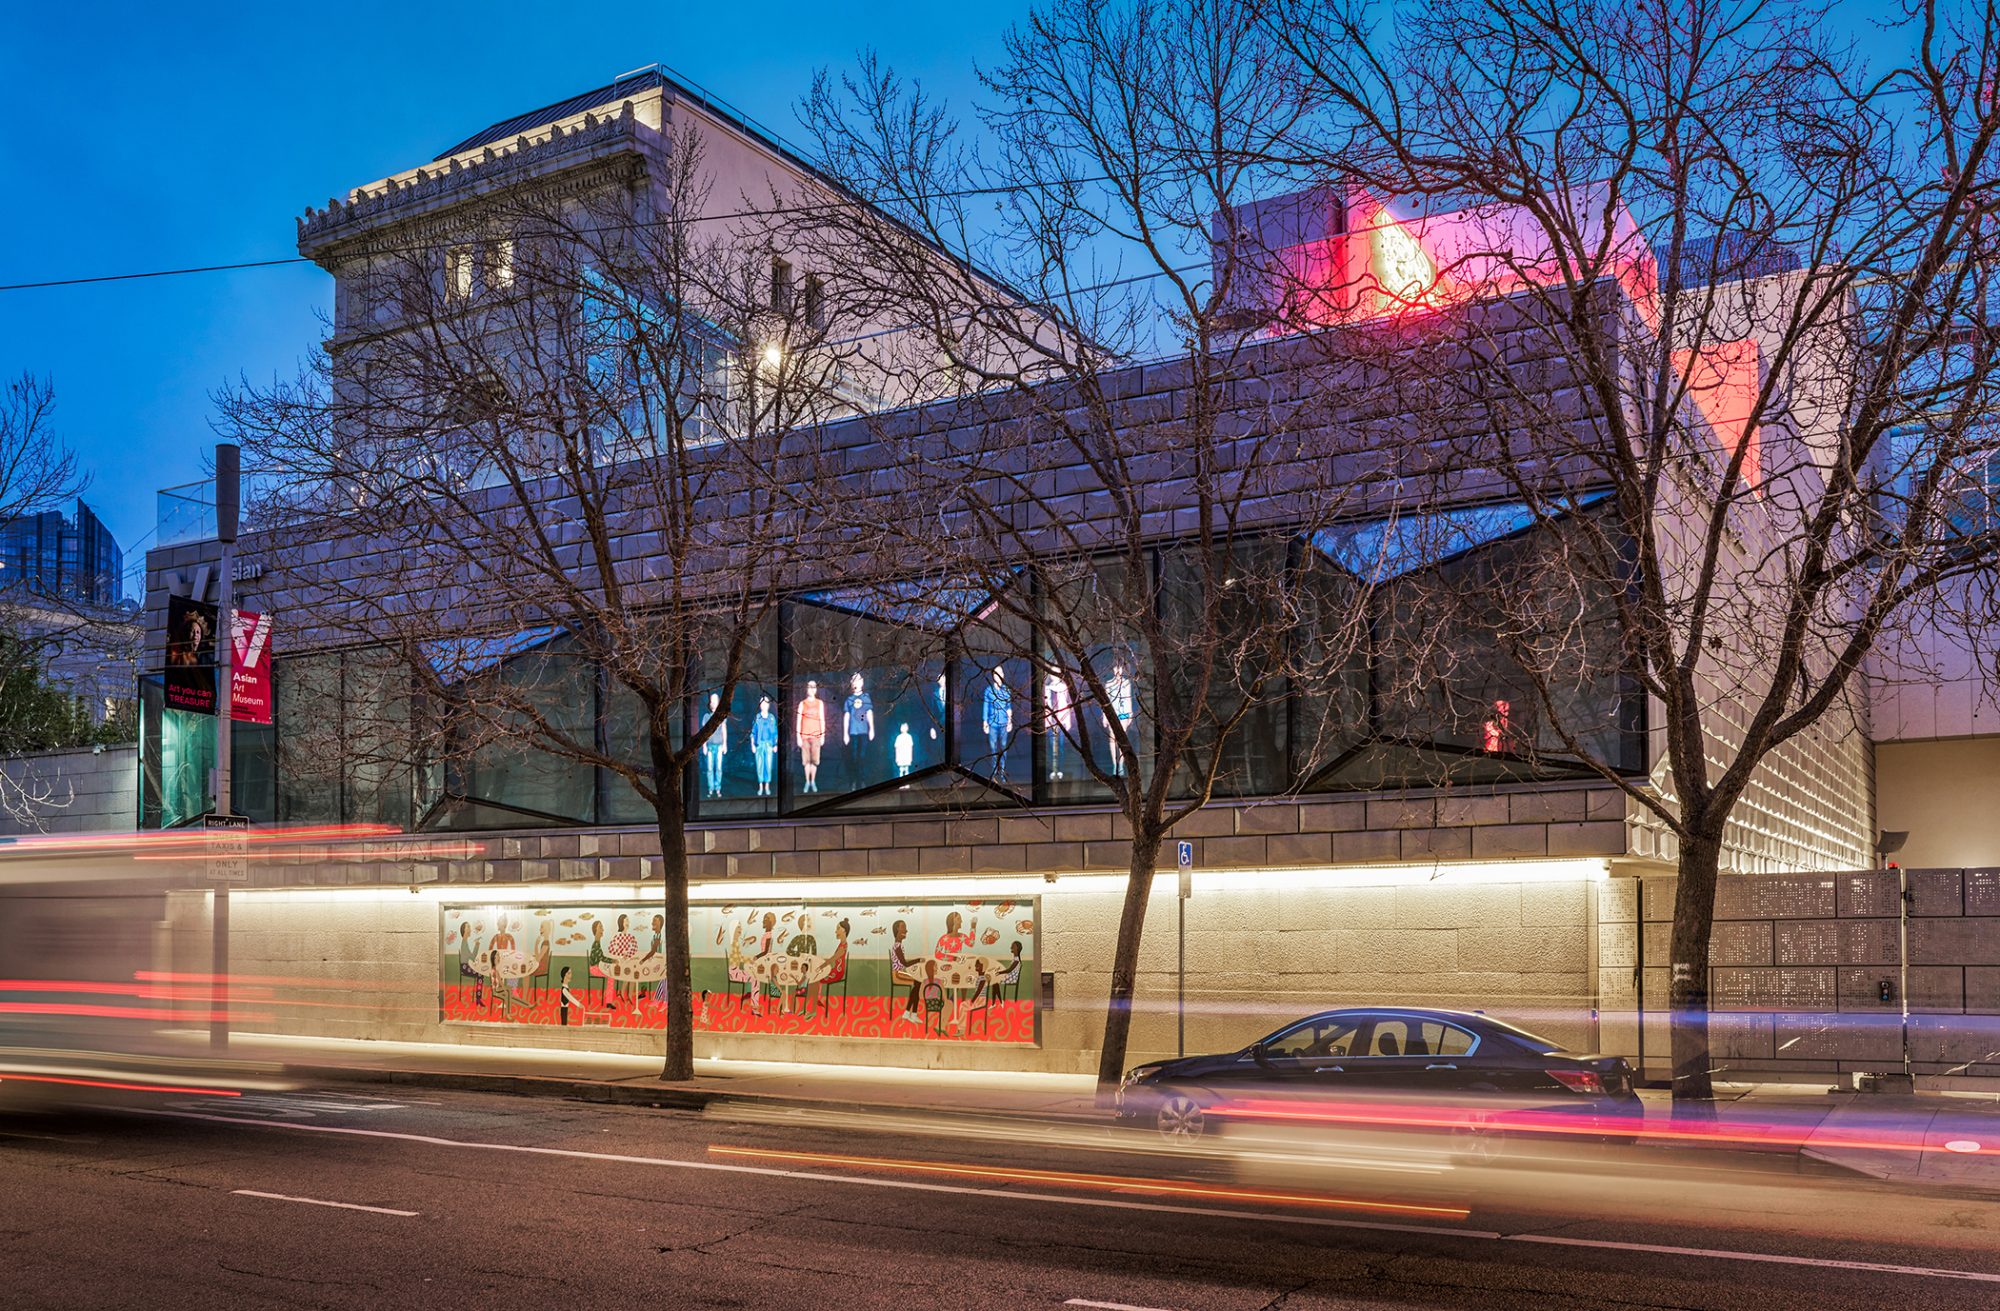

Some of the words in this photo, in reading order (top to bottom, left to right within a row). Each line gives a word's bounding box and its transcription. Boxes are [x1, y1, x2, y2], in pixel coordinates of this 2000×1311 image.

[233, 672, 257, 684] Asian
[169, 684, 180, 693] Art
[181, 687, 196, 696] you
[197, 690, 212, 698] can
[233, 682, 245, 693] Art
[169, 693, 211, 707] TREASURE
[233, 692, 264, 705] Museum
[207, 820, 226, 828] RIGHT
[215, 860, 238, 869] ONLY
